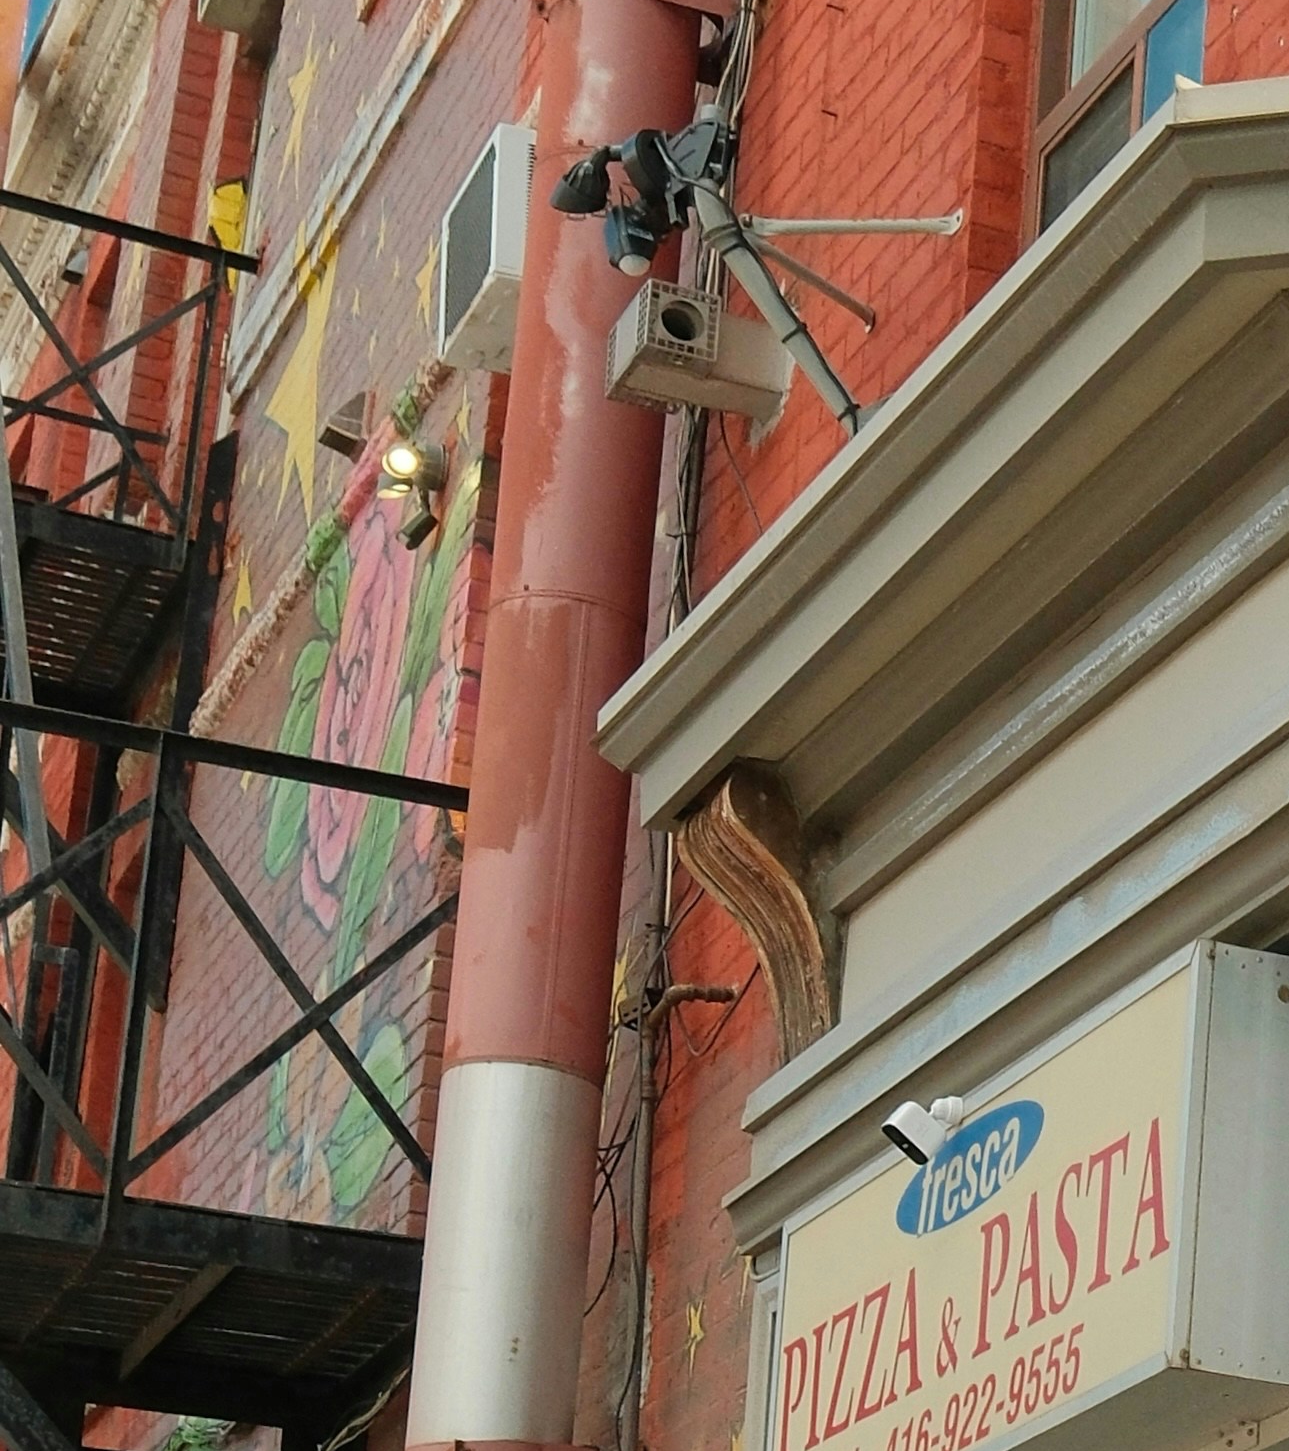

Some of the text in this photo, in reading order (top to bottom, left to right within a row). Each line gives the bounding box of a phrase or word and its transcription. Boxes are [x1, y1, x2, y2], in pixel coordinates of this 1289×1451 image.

[917, 1116, 1022, 1238] fresca
[936, 1297, 961, 1378] &
[972, 1117, 1171, 1359] PASTA
